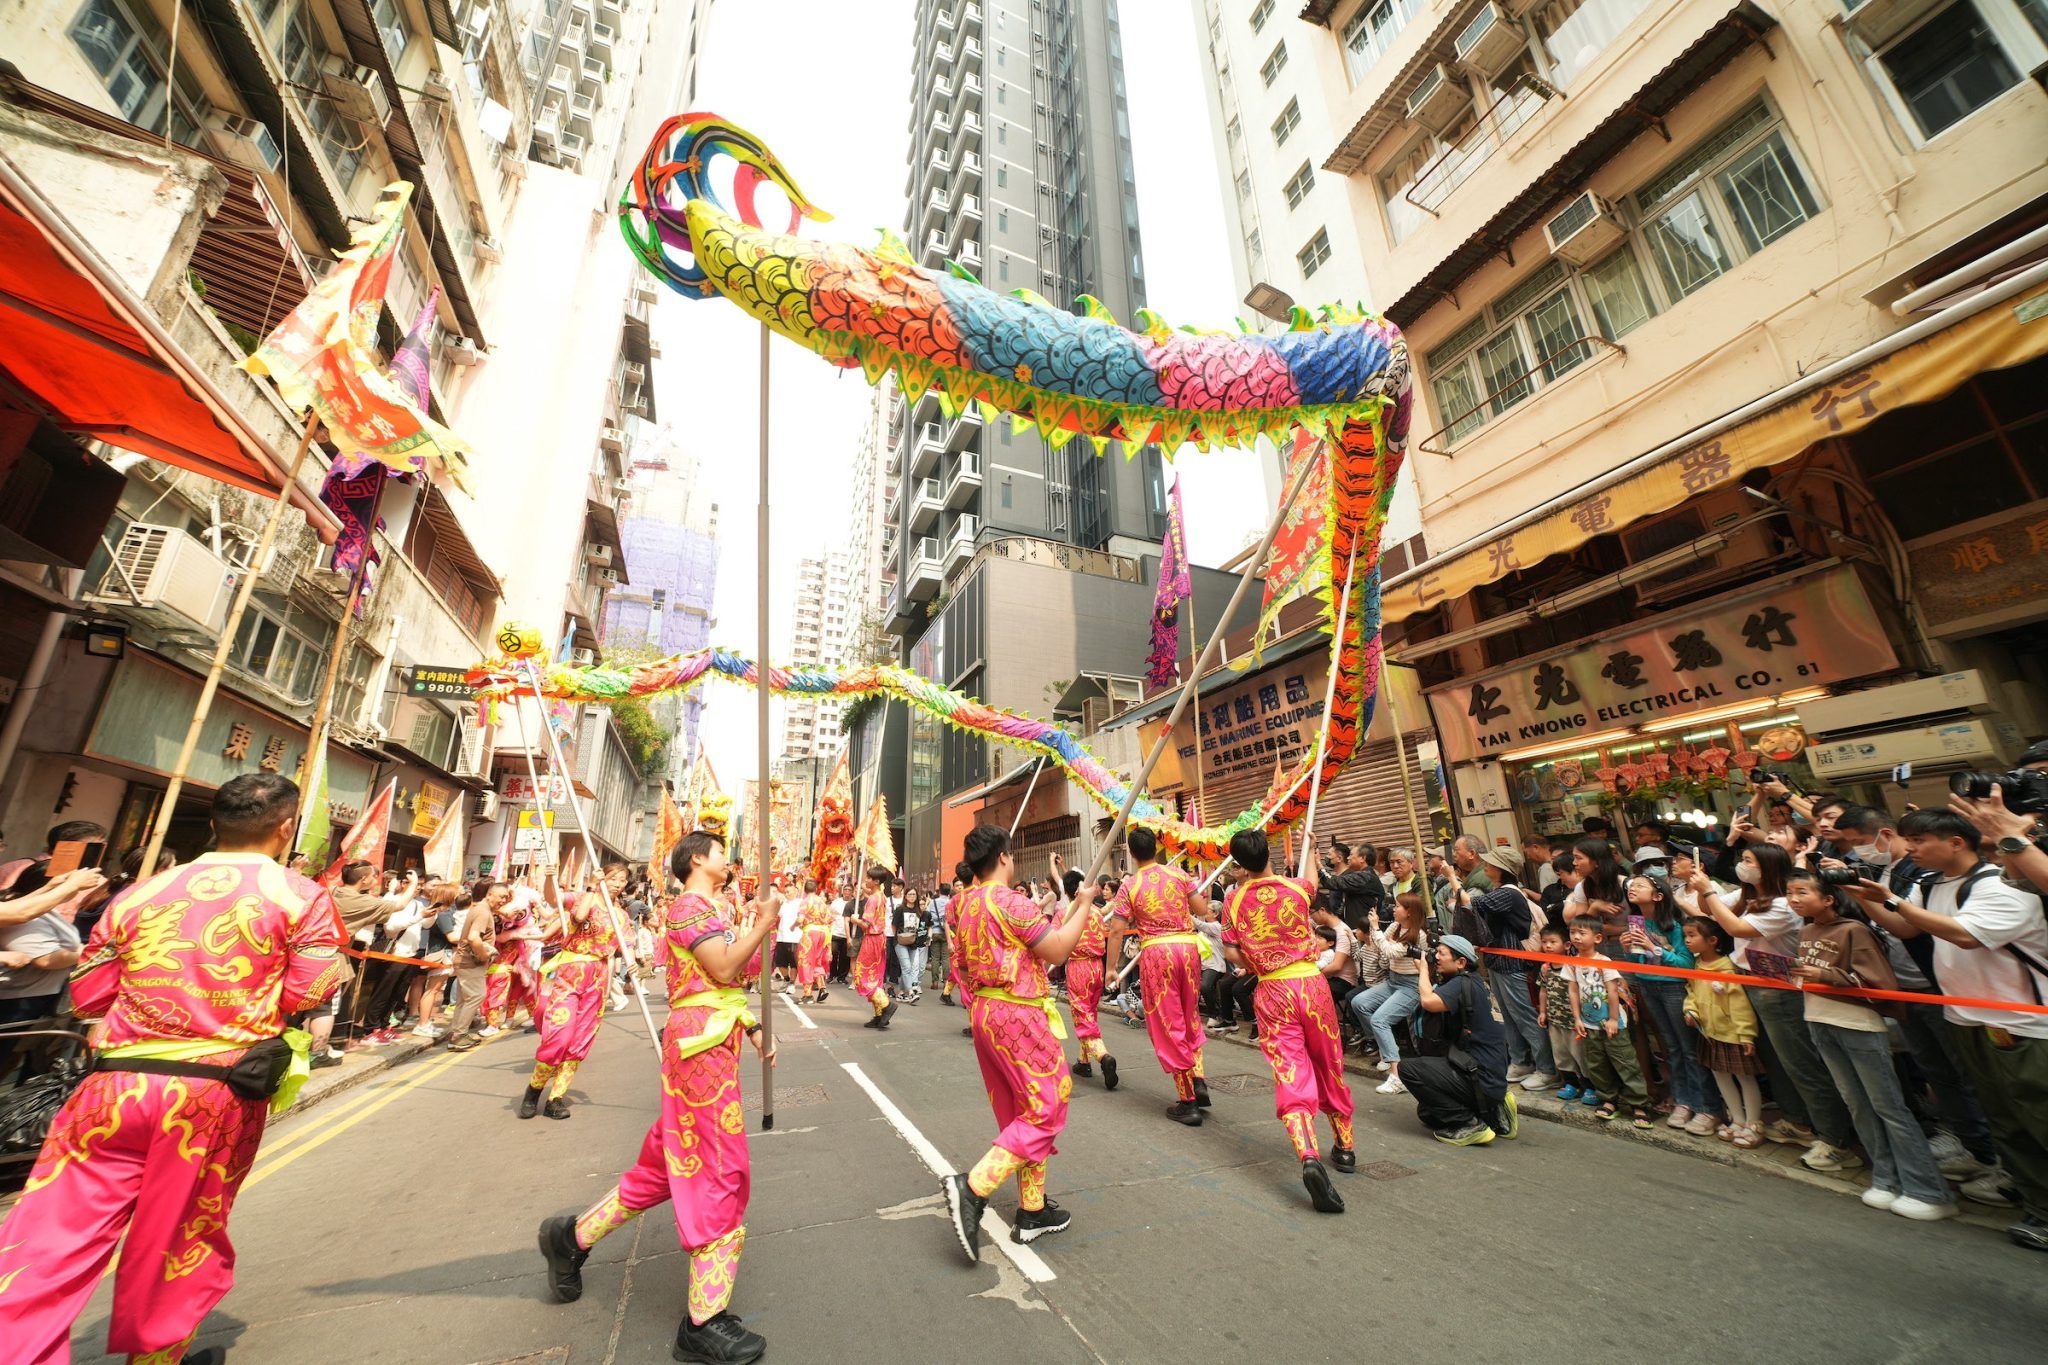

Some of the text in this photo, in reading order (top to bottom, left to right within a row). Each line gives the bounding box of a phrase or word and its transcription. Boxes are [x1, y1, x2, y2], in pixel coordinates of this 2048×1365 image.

[1412, 373, 1881, 607] 仁光電器行
[1177, 744, 1196, 759] YEE
[1219, 723, 1263, 747] MARINE
[1265, 700, 1326, 731] EQUIPME
[1477, 662, 1820, 748] YAN KWONG ELECTRICAL CO. 81
[1258, 748, 1301, 766] EQUIMENT
[119, 894, 273, 973] 姜氏
[1247, 896, 1305, 942] 姜氏
[184, 982, 210, 999] LION
[212, 988, 253, 999] DANCE
[211, 997, 247, 1008] TEAM
